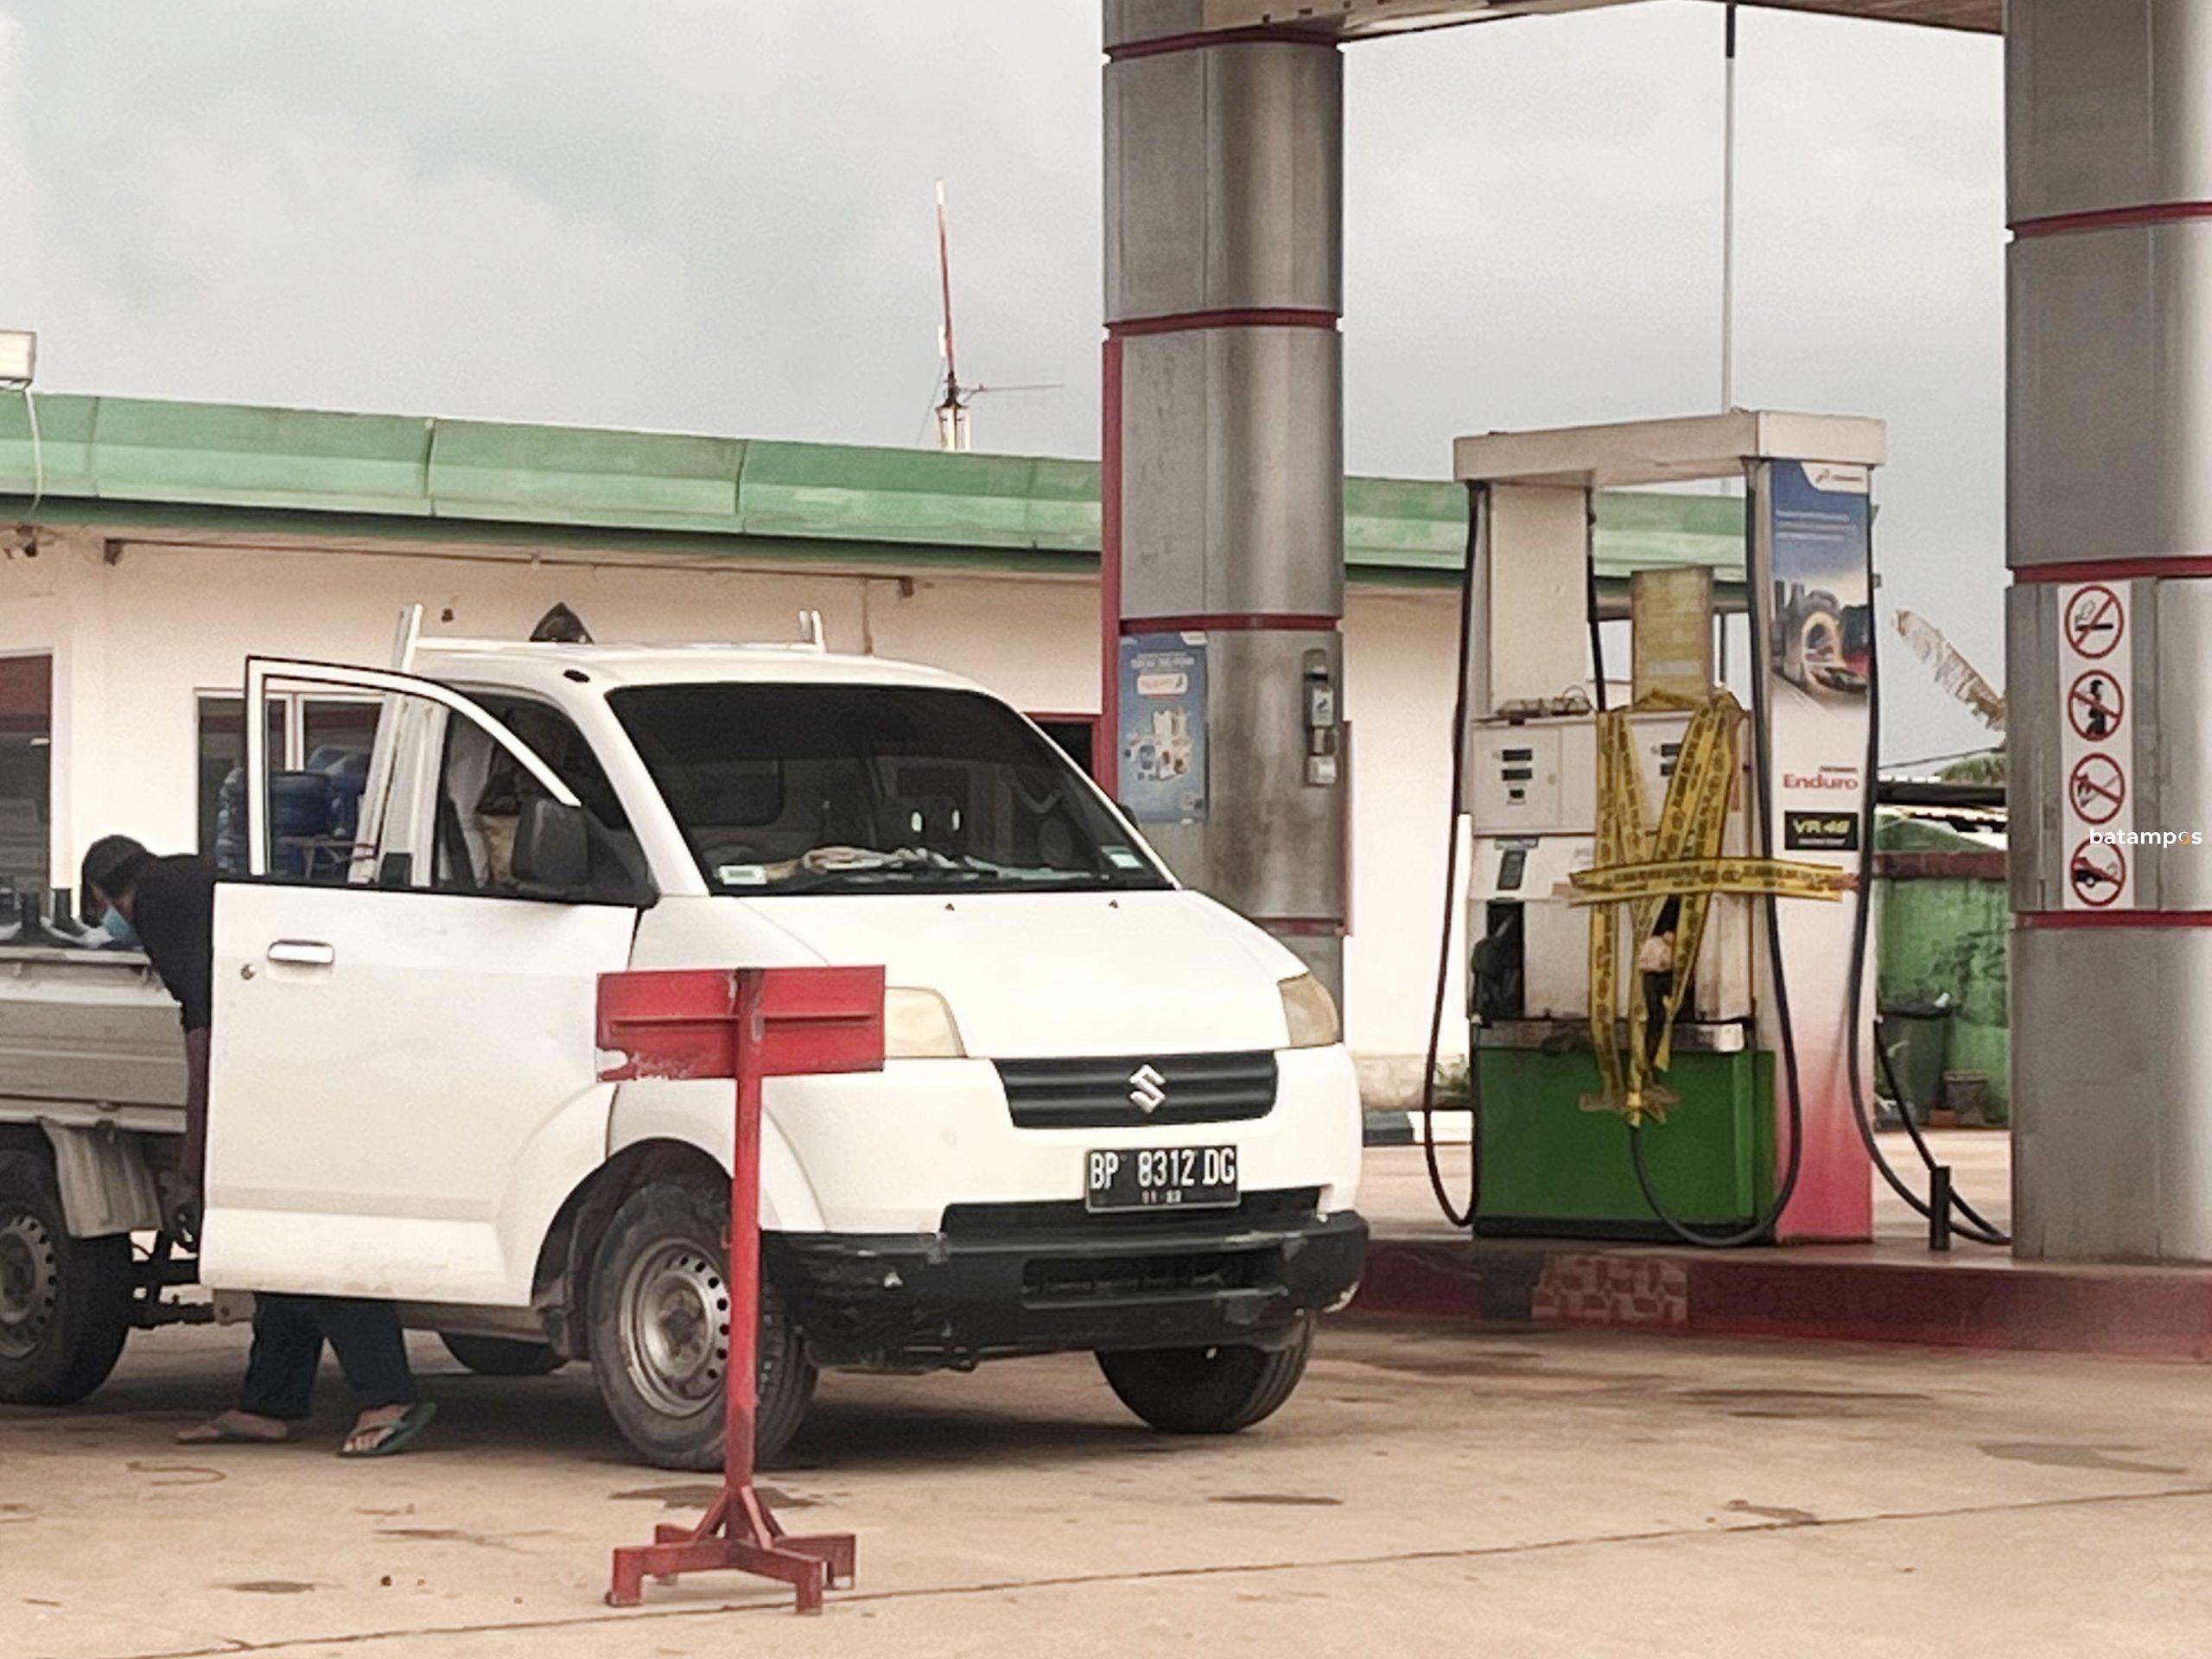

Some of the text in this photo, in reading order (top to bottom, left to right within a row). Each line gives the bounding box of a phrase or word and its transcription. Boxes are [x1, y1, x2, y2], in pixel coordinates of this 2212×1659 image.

[1783, 774, 1858, 790] Enduro
[1090, 1147, 1235, 1189] BP 8312 DG
